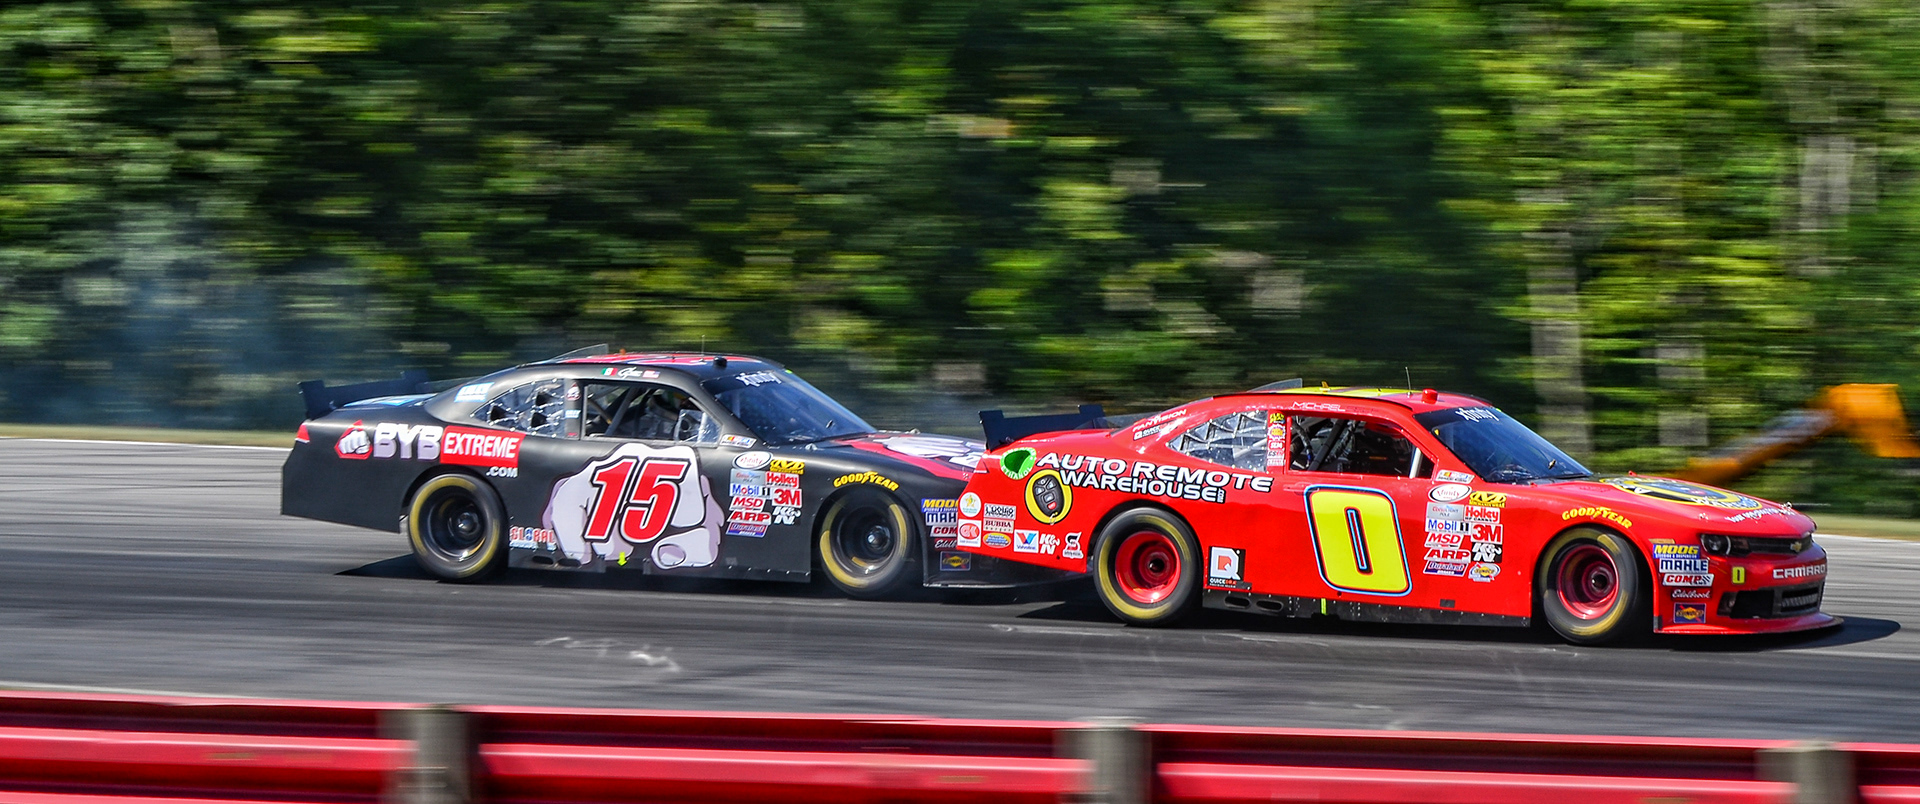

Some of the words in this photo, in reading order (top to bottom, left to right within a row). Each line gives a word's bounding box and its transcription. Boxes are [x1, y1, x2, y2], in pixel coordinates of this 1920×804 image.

[373, 423, 443, 460] BYB
[444, 433, 520, 459] EXTREME
[486, 466, 518, 478] .COM
[1036, 452, 1127, 477] AUTO
[1132, 461, 1274, 493] REMOTE
[766, 473, 798, 487] Holley
[833, 471, 899, 491] GOODYEAR
[1059, 470, 1217, 503] WAREHOUSE
[733, 484, 759, 496] Mobil
[774, 489, 801, 506] 3M
[586, 458, 691, 542] 15
[733, 497, 763, 508] MSD
[923, 500, 958, 508] MOO
[731, 511, 770, 522] ARP
[772, 506, 802, 524] K&N
[927, 513, 958, 523] MAH
[1466, 507, 1498, 522] Holley
[1562, 507, 1633, 529] GOODYEAR
[934, 527, 957, 535] COM
[1428, 519, 1457, 531] Mobil
[1428, 533, 1461, 545] MSD
[1473, 524, 1501, 542] 3M
[1039, 533, 1061, 554] K&N
[1306, 487, 1411, 595] 0
[1427, 550, 1469, 560] ARP
[1471, 542, 1503, 562] K&N
[1655, 545, 1699, 554] MOOG
[1661, 559, 1708, 571] MAHLE
[1773, 564, 1827, 579] CAMARO
[1666, 575, 1703, 584] COMP
[1732, 566, 1745, 584] 0
